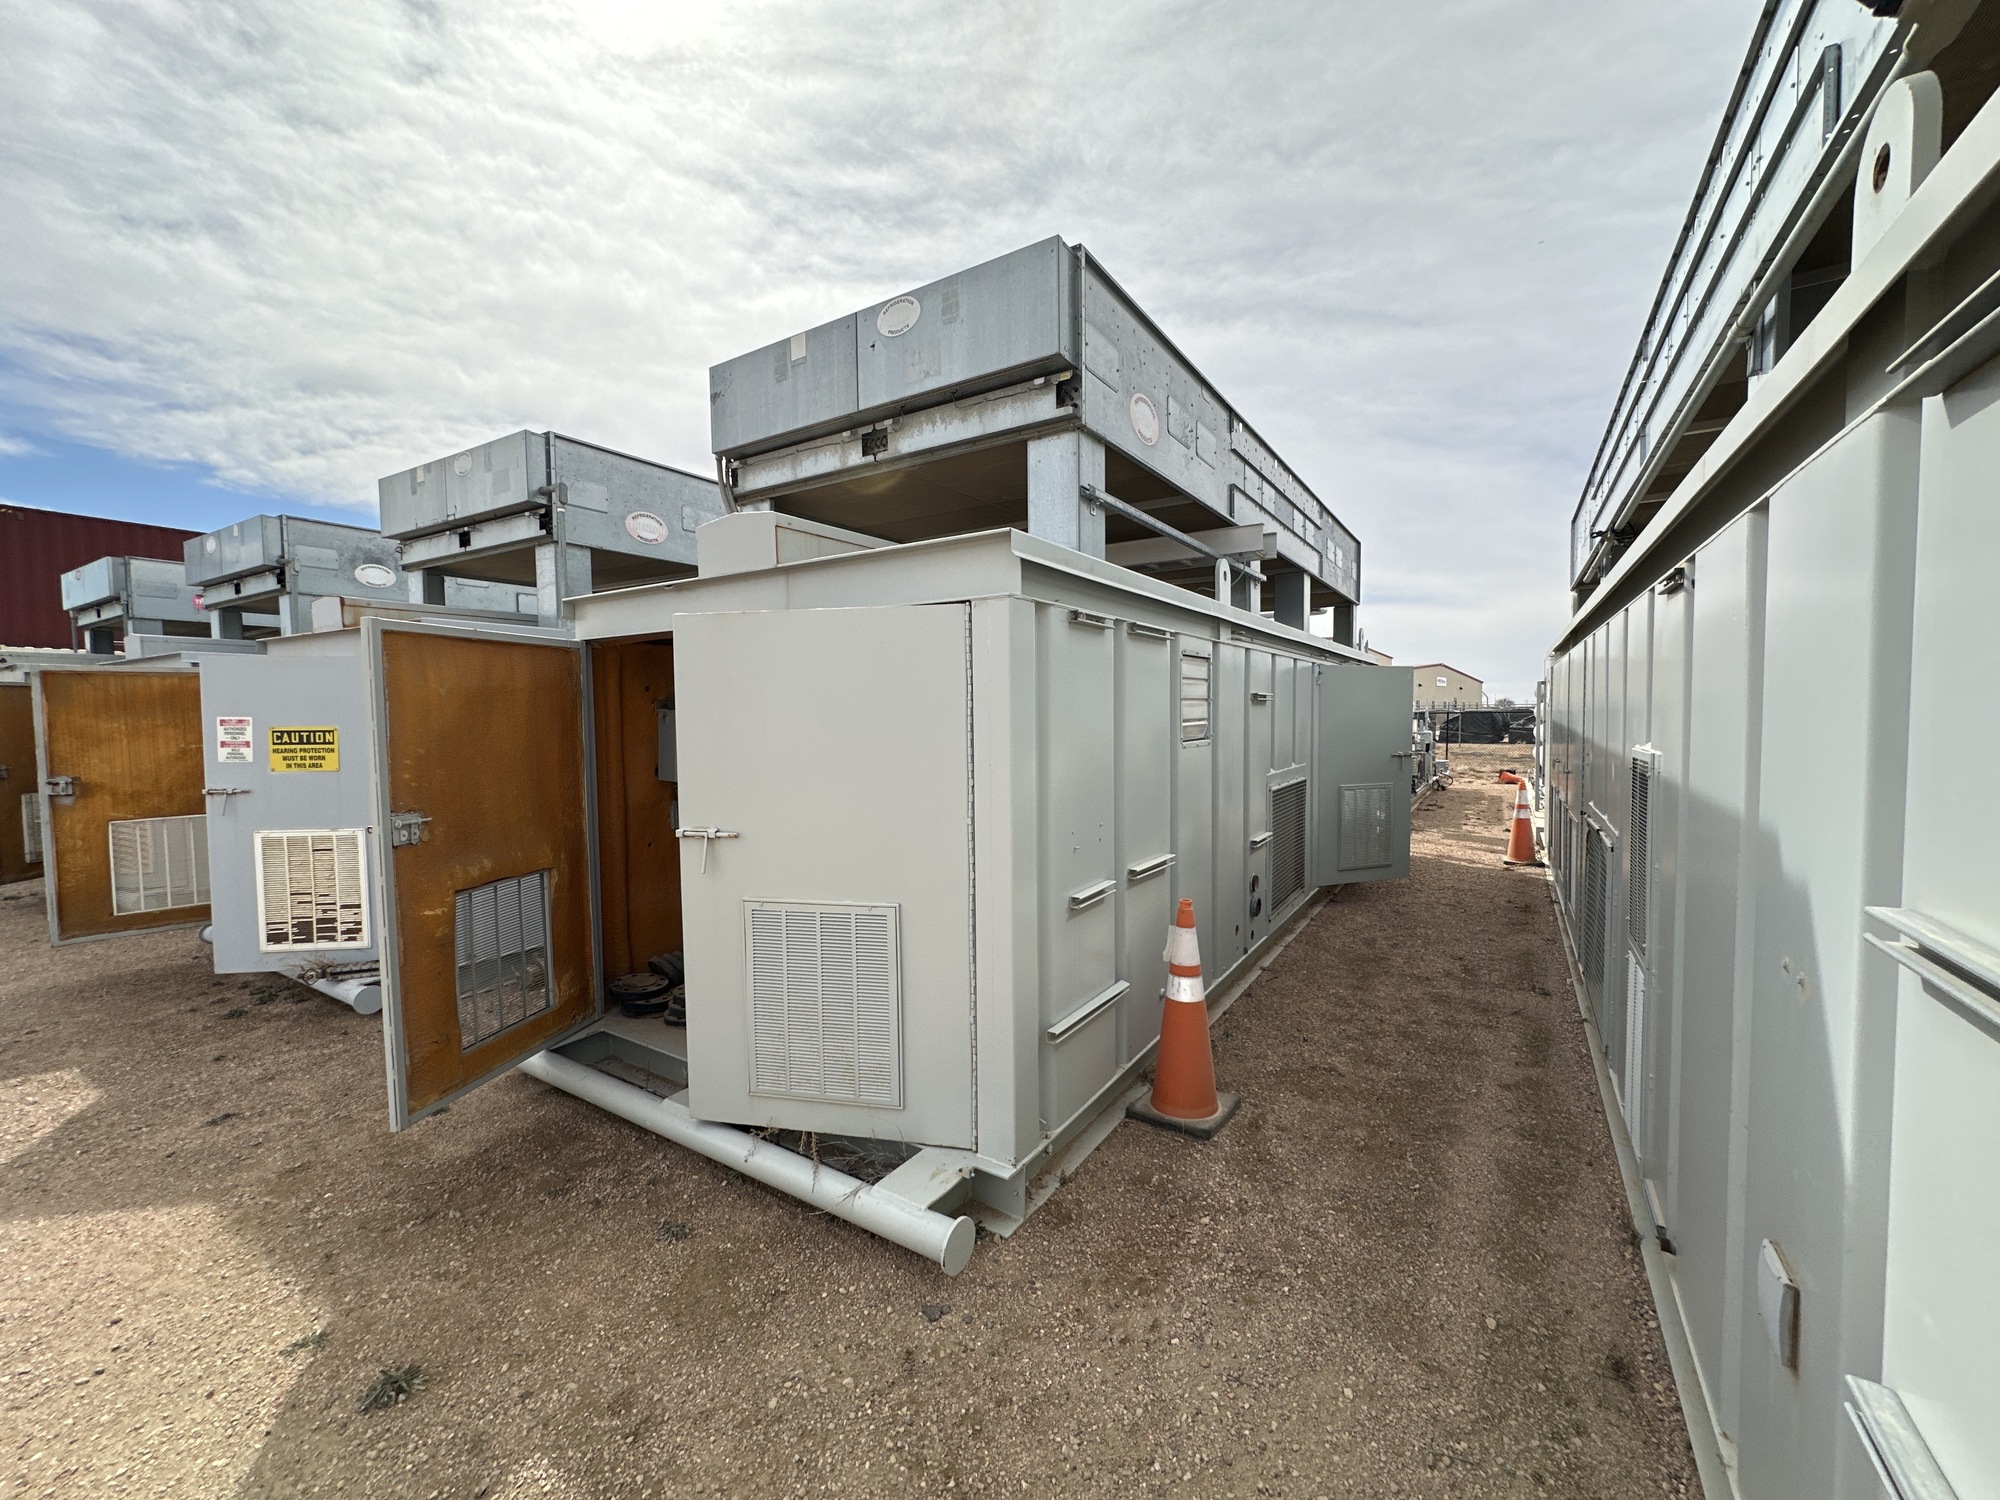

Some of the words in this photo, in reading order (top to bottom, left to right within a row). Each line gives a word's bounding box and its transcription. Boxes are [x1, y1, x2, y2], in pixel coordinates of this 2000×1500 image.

[883, 298, 914, 315] REFRIGERATION
[888, 323, 910, 335] PRODUCTS
[632, 513, 663, 526] REFRIGERATION
[637, 534, 659, 543] PRODUCTS
[273, 732, 334, 743] CAUTION
